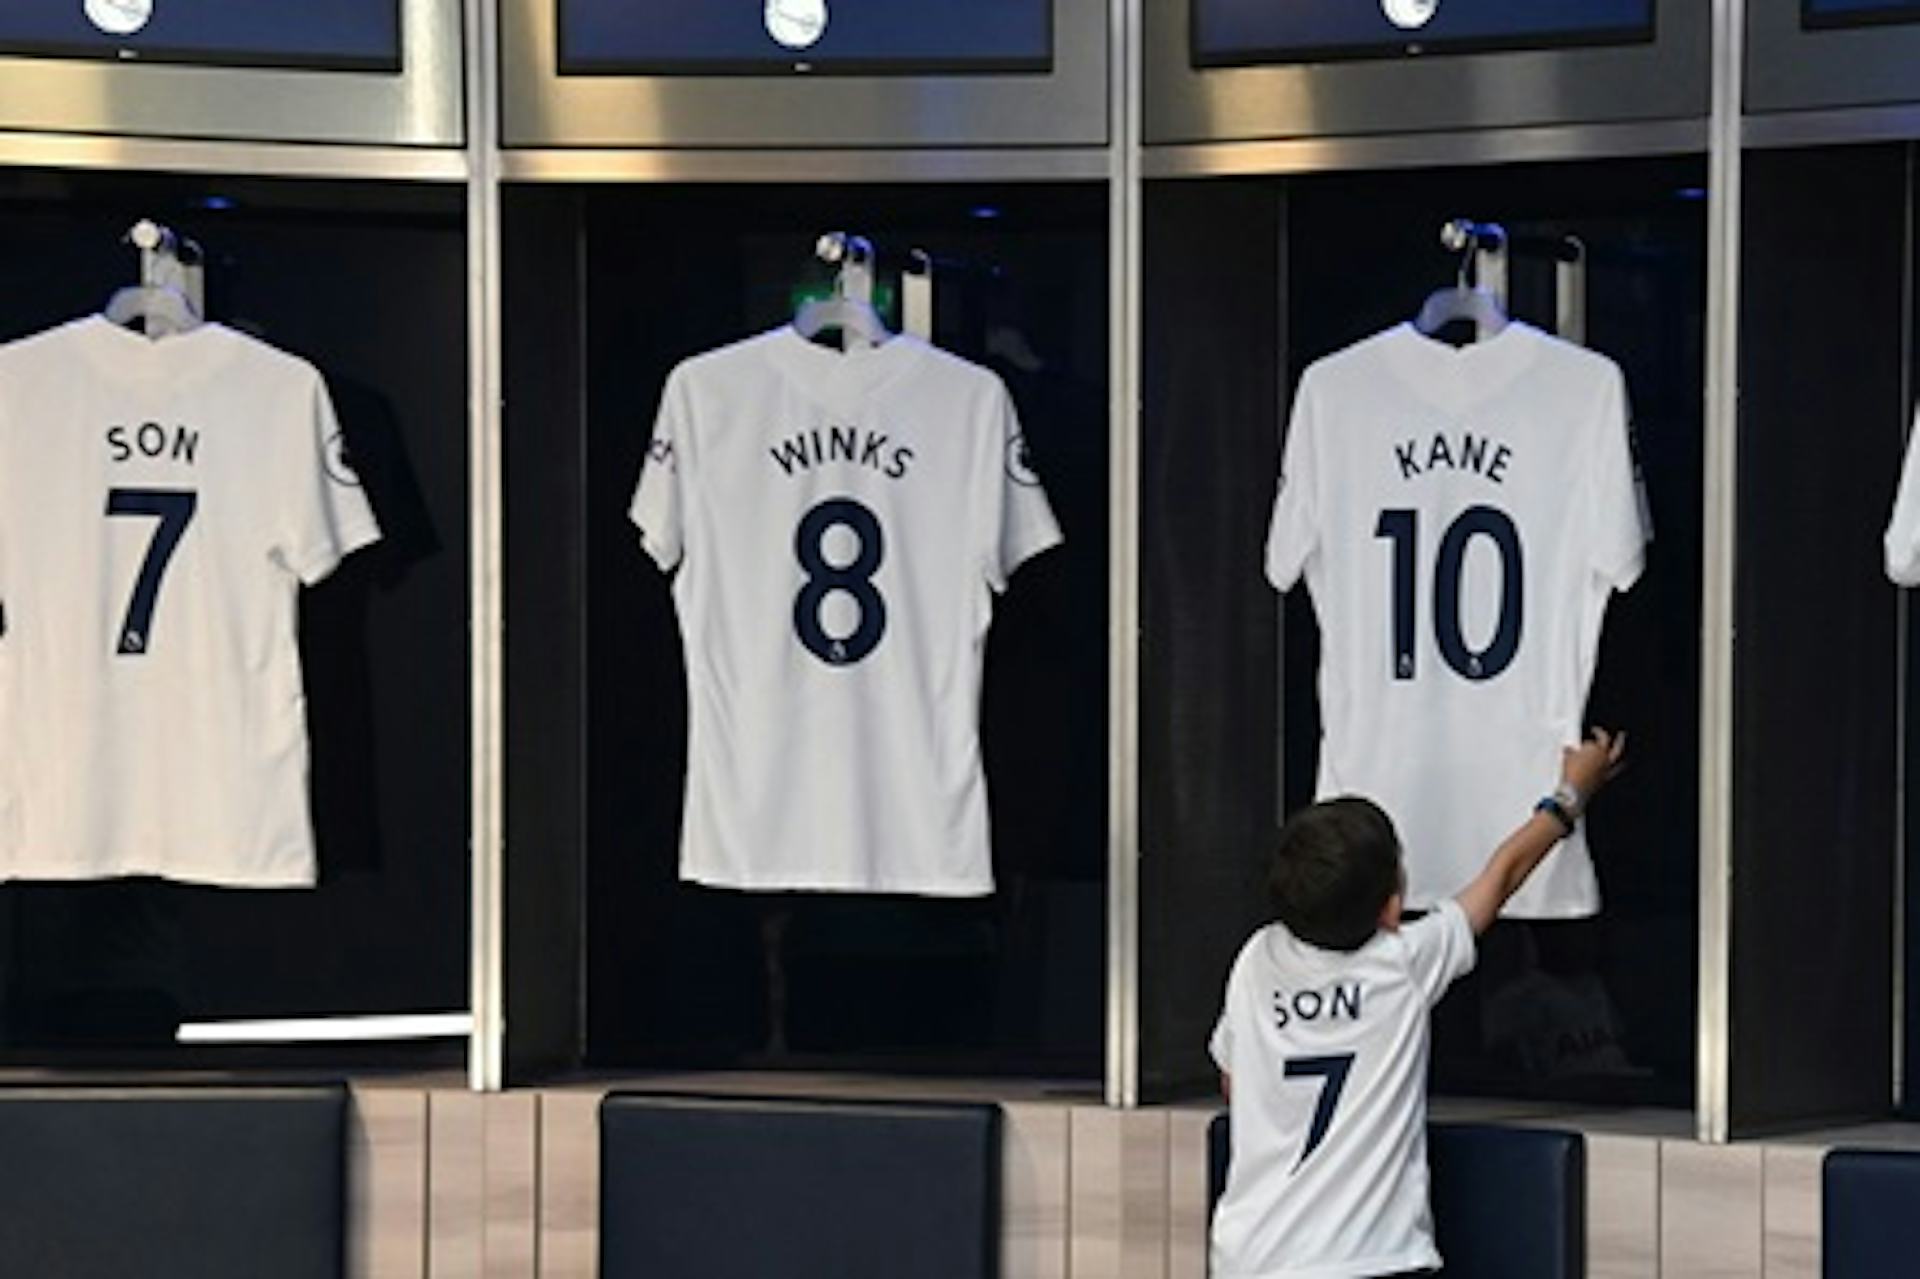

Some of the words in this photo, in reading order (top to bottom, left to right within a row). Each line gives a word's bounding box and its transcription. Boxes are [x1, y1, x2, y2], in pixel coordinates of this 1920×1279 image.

[107, 422, 199, 464] SON
[770, 426, 915, 479] WINKS
[1395, 432, 1512, 484] KANE
[105, 488, 197, 655] 7
[793, 497, 886, 666] 8
[1374, 504, 1524, 682] 10
[1274, 984, 1361, 1029] SON
[1283, 1052, 1356, 1175] 7
